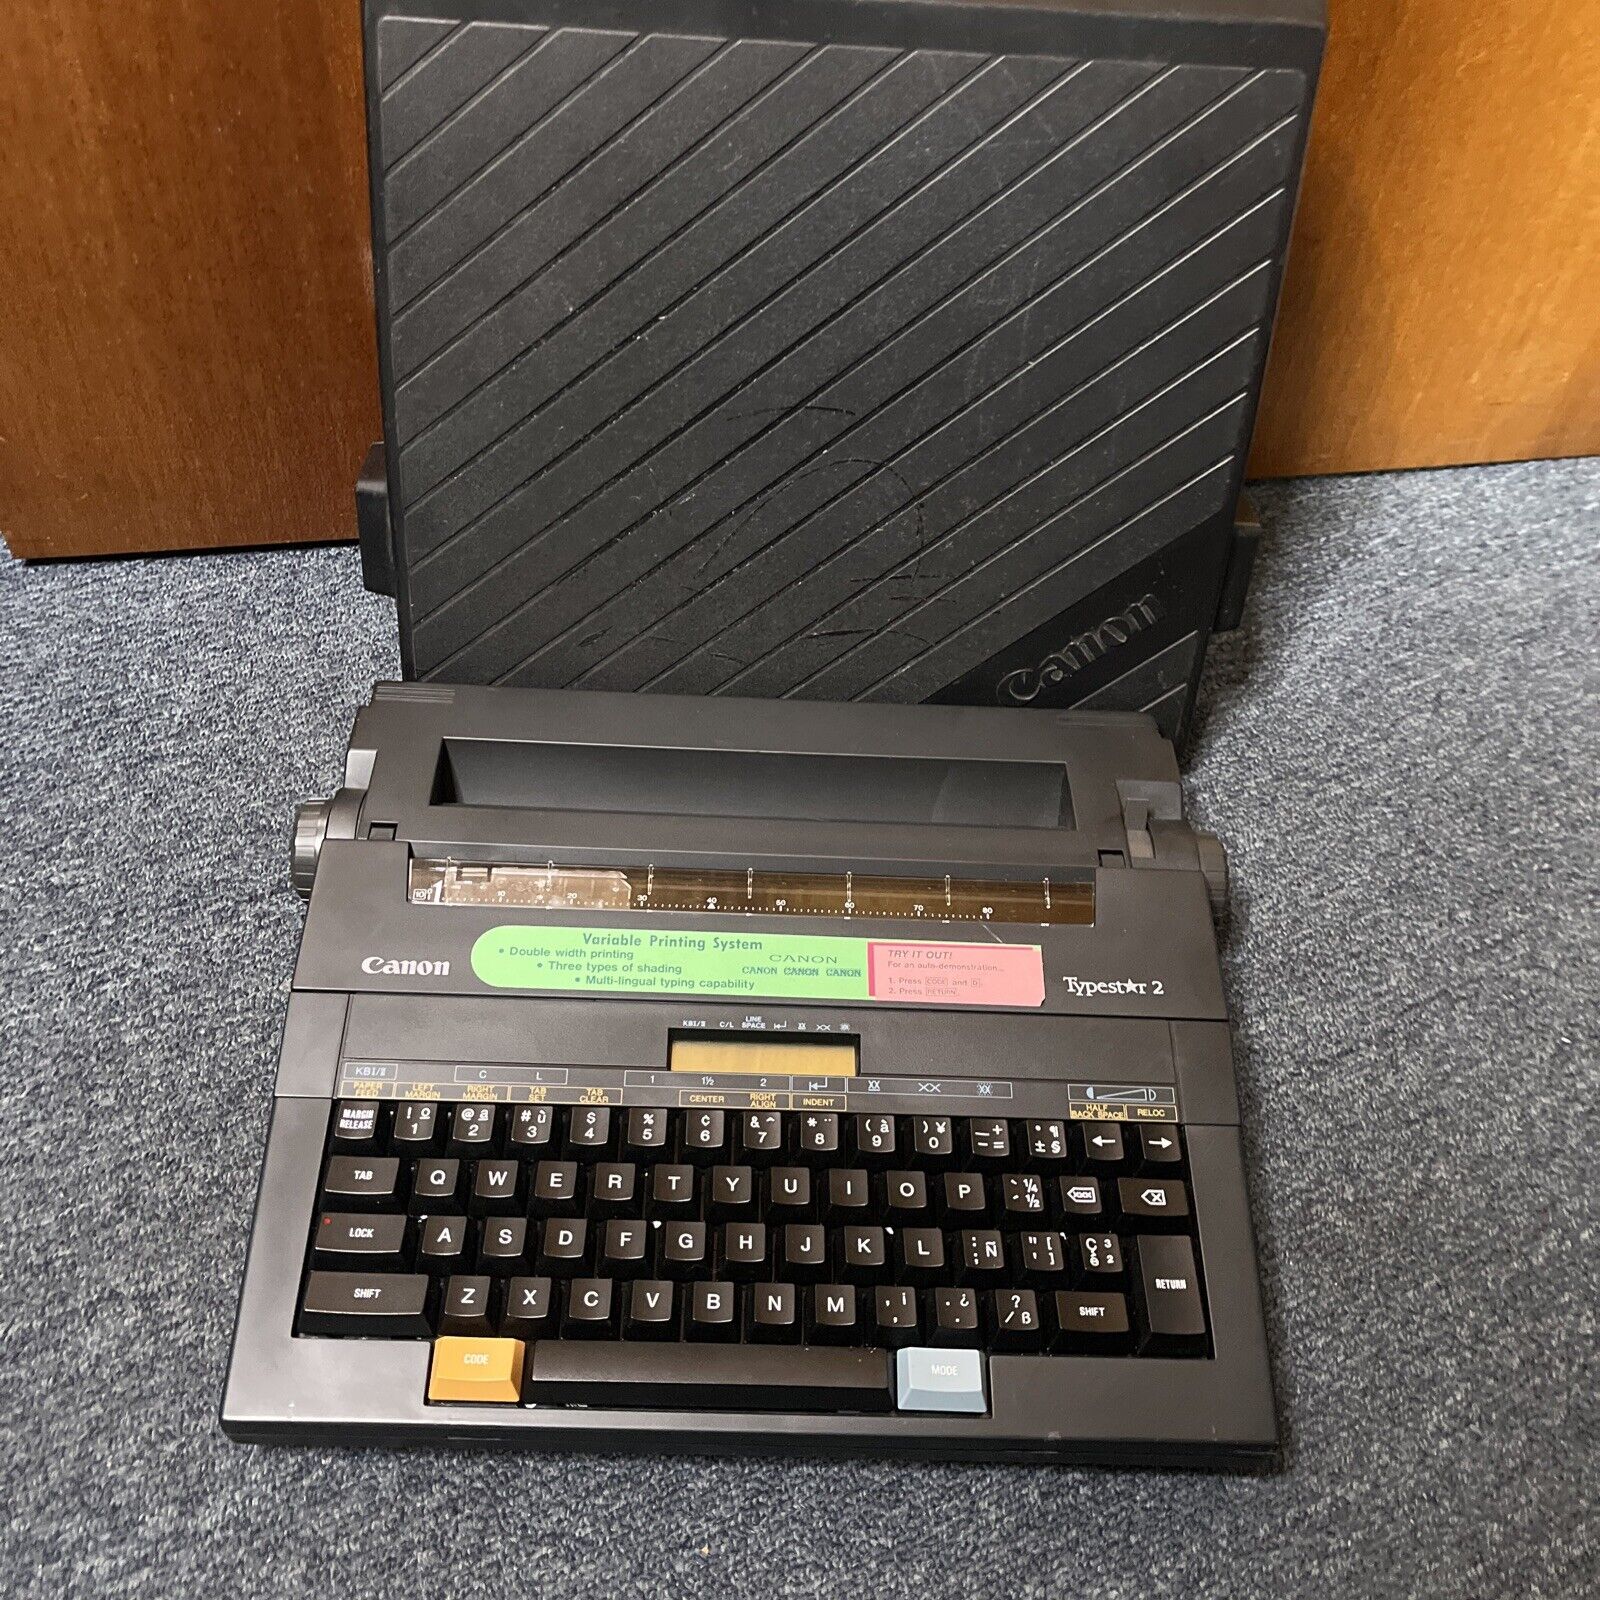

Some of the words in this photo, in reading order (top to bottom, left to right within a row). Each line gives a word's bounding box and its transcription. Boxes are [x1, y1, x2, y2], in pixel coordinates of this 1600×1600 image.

[996, 593, 1160, 702] Canon
[567, 892, 578, 900] 20
[636, 894, 648, 902] 30
[706, 897, 718, 905] 40
[913, 904, 924, 912] 70
[583, 932, 642, 946] Variable
[649, 935, 706, 951] Printing
[713, 937, 763, 952] System
[509, 946, 551, 957] Double
[555, 947, 586, 958] width
[590, 949, 634, 961] printing
[769, 954, 838, 964] CANON
[888, 950, 910, 958] TRY
[926, 951, 953, 959] OUT!
[361, 956, 450, 976] Canon
[548, 960, 582, 971] Three
[586, 962, 618, 973] types
[622, 963, 633, 972] of
[637, 964, 682, 975] shading
[742, 966, 778, 975] CANON
[783, 967, 819, 976] CANON
[826, 968, 862, 977] CANON
[585, 975, 656, 987] Multi-lingual
[660, 979, 695, 989] typing
[699, 979, 755, 991] capability
[1151, 980, 1164, 995] 2
[479, 1070, 487, 1079] C
[536, 1072, 543, 1080] L
[650, 1075, 655, 1084] 1
[353, 1081, 383, 1089] PAPER
[467, 1085, 495, 1093] RIGHT
[760, 1078, 767, 1087] 2
[405, 1091, 441, 1100] MARGIN
[463, 1092, 498, 1101] MARGIN
[530, 1087, 547, 1095] TAB
[749, 1093, 776, 1101] RIGHT
[528, 1094, 545, 1102] SET
[689, 1094, 725, 1103] CENTER
[803, 1098, 834, 1107] INDENT
[343, 1109, 375, 1119] MARGIN
[461, 1108, 475, 1121] @
[521, 1110, 532, 1122] #
[586, 1112, 596, 1124] $
[643, 1113, 654, 1125] %
[1137, 1109, 1166, 1117] RELOC
[340, 1119, 373, 1129] RELEASE
[750, 1116, 760, 1128] &
[865, 1119, 871, 1132] (
[923, 1120, 929, 1133] )
[411, 1123, 418, 1135] 1
[468, 1124, 479, 1136] 2
[527, 1126, 537, 1138] 3
[585, 1127, 595, 1139] 4
[642, 1128, 653, 1140] 5
[700, 1130, 711, 1142] 6
[758, 1131, 768, 1143] 7
[815, 1133, 825, 1145] 8
[872, 1135, 882, 1147] 9
[355, 1171, 373, 1180] TAB
[430, 1170, 446, 1185] Q
[488, 1171, 508, 1186] W
[550, 1173, 563, 1188] E
[608, 1175, 623, 1189] R
[667, 1176, 681, 1190] T
[725, 1177, 740, 1192] Y
[784, 1179, 798, 1194] U
[846, 1181, 852, 1195] I
[899, 1183, 914, 1197] O
[958, 1184, 971, 1199] P
[349, 1228, 374, 1238] LOCK
[437, 1228, 452, 1243] A
[498, 1229, 513, 1244] S
[558, 1231, 573, 1246] D
[620, 1232, 633, 1246] F
[678, 1234, 694, 1249] G
[739, 1235, 753, 1250] H
[800, 1237, 811, 1252] J
[857, 1238, 872, 1254] K
[917, 1240, 931, 1256] L
[1155, 1278, 1187, 1290] RETURN
[353, 1287, 382, 1299] SHIFT
[461, 1288, 476, 1304] Z
[522, 1289, 537, 1305] X
[584, 1291, 599, 1307] C
[646, 1293, 660, 1308] V
[706, 1294, 721, 1310] B
[768, 1296, 782, 1312] N
[827, 1297, 845, 1313] M
[1011, 1294, 1021, 1309] ?
[1079, 1306, 1105, 1317] SHIFT
[463, 1353, 489, 1366] CODE
[931, 1361, 961, 1376] MODE
